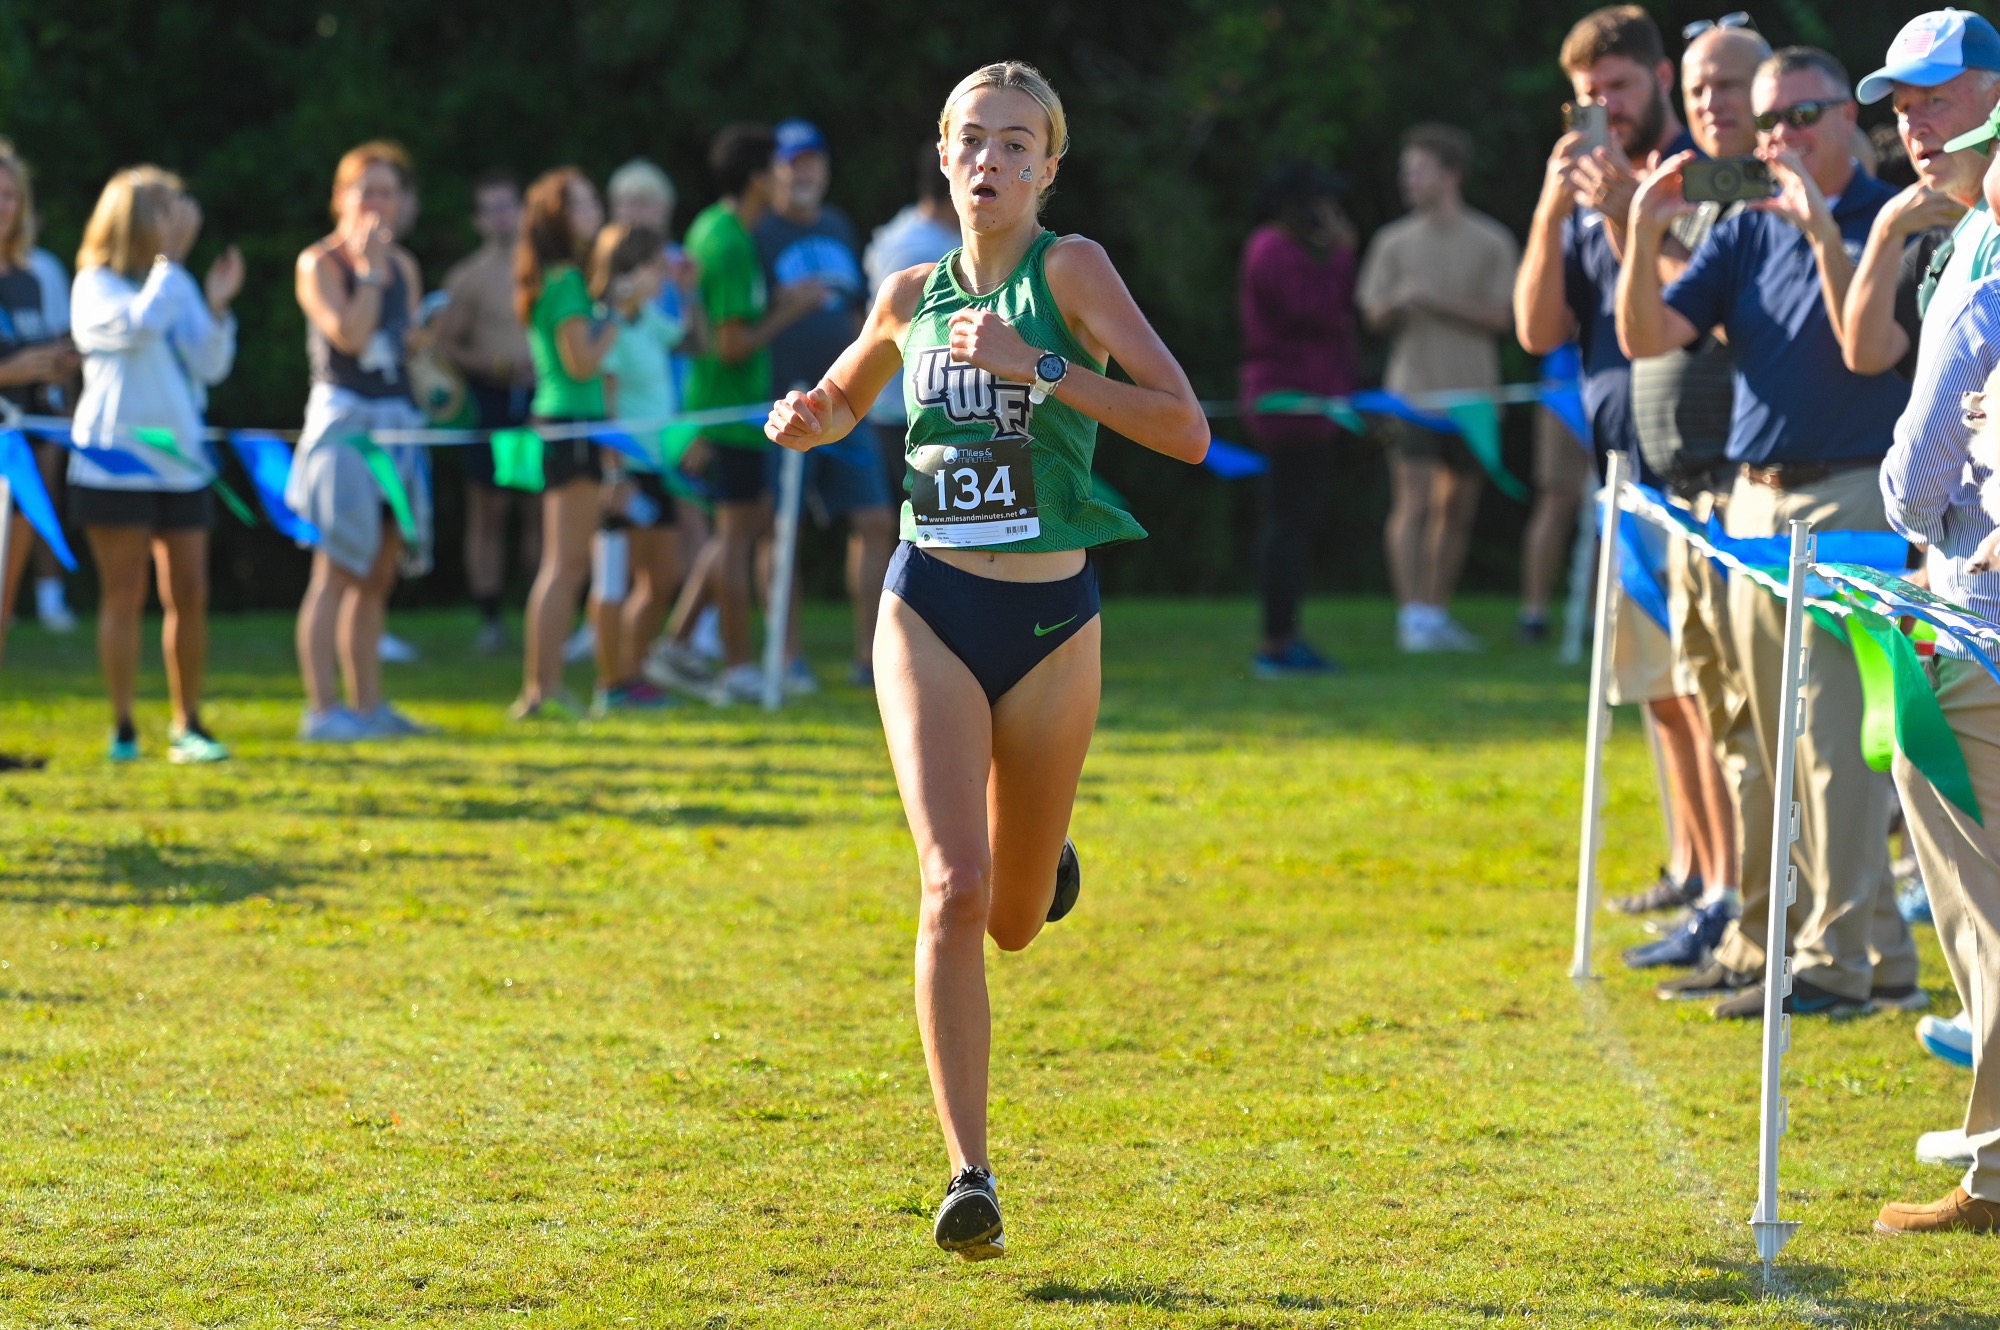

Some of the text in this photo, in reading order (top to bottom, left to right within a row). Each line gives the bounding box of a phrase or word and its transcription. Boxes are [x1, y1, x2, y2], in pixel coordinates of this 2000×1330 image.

[914, 348, 1033, 439] UWF
[934, 465, 1016, 511] 134
[929, 511, 1018, 523] www.milesandminutes.net
